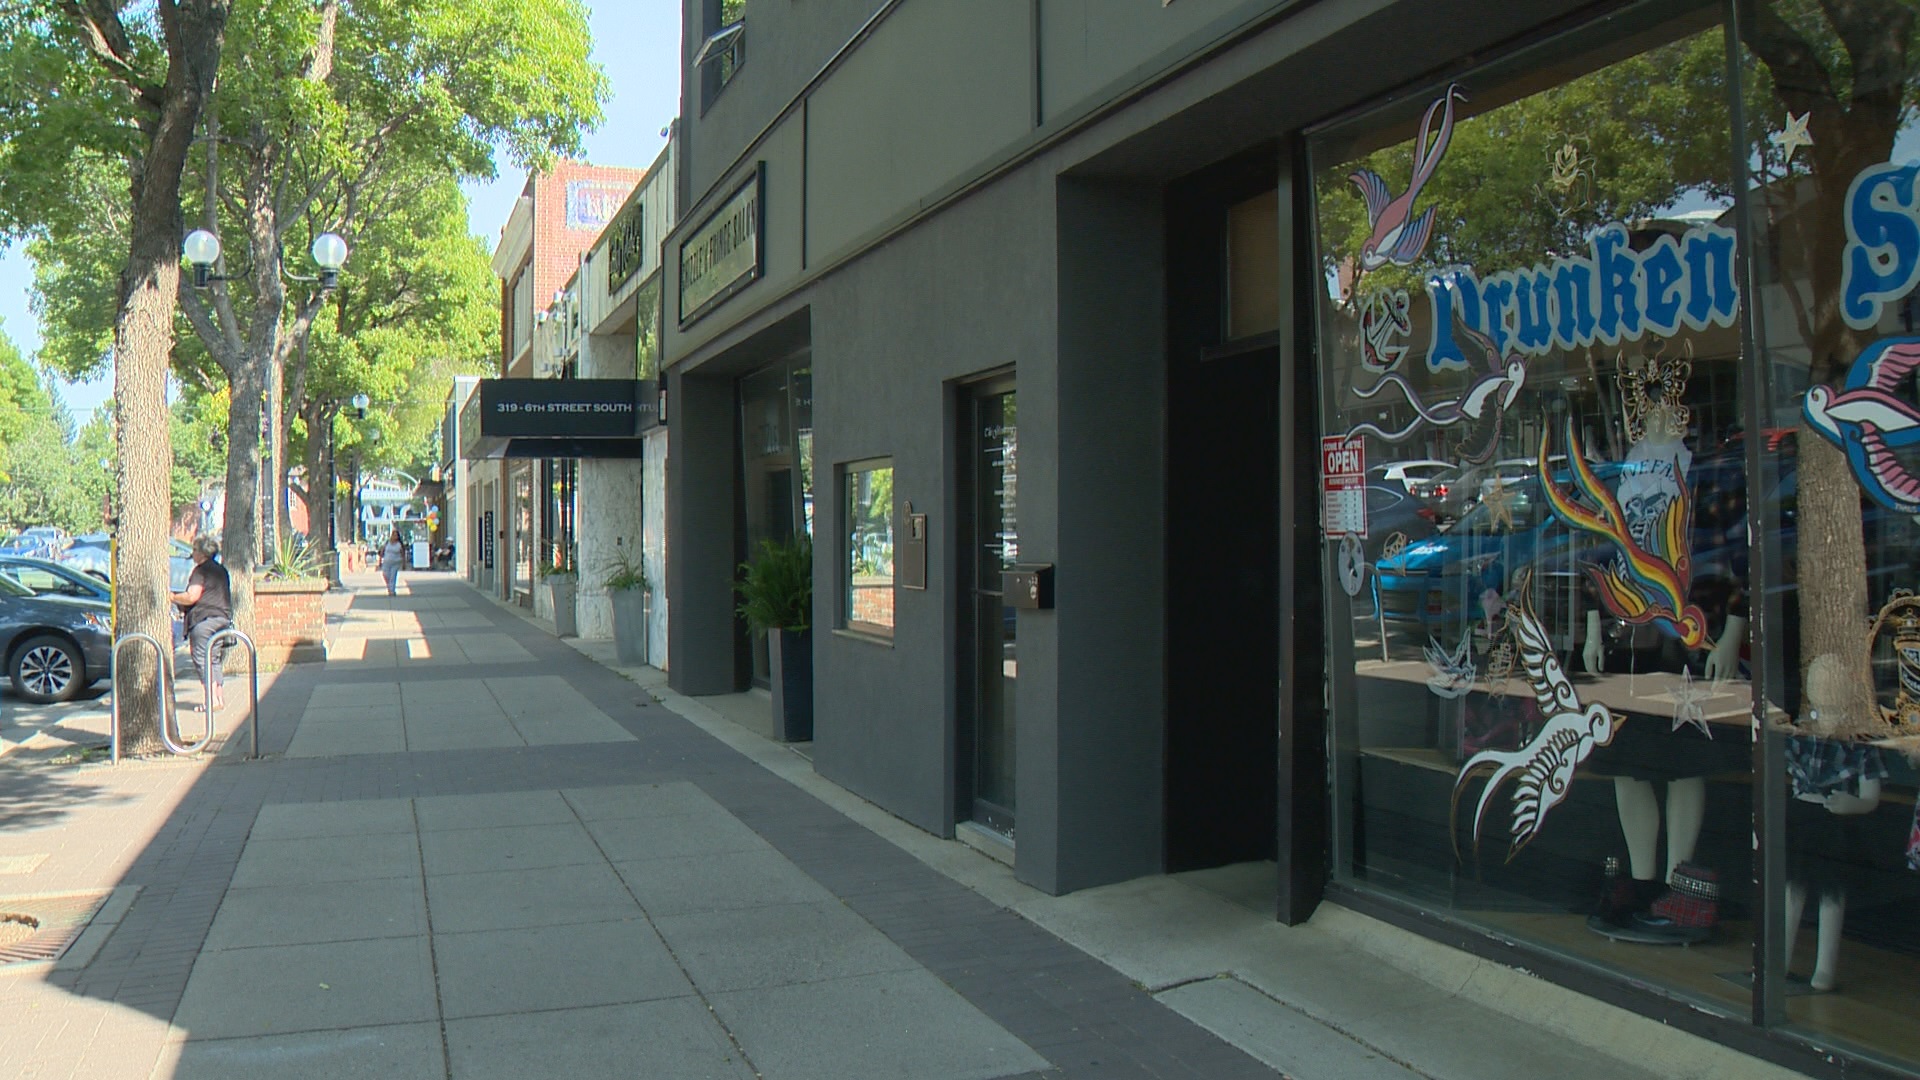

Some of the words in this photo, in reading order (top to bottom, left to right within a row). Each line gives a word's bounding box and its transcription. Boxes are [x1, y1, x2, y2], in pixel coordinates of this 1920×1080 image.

[709, 219, 731, 270] FRINGE
[733, 198, 757, 250] SALON
[1426, 223, 1737, 373] Drunken
[497, 403, 518, 412] 319
[547, 403, 592, 412] STREET
[593, 403, 632, 412] SOUTH
[1327, 450, 1359, 473] OPEN
